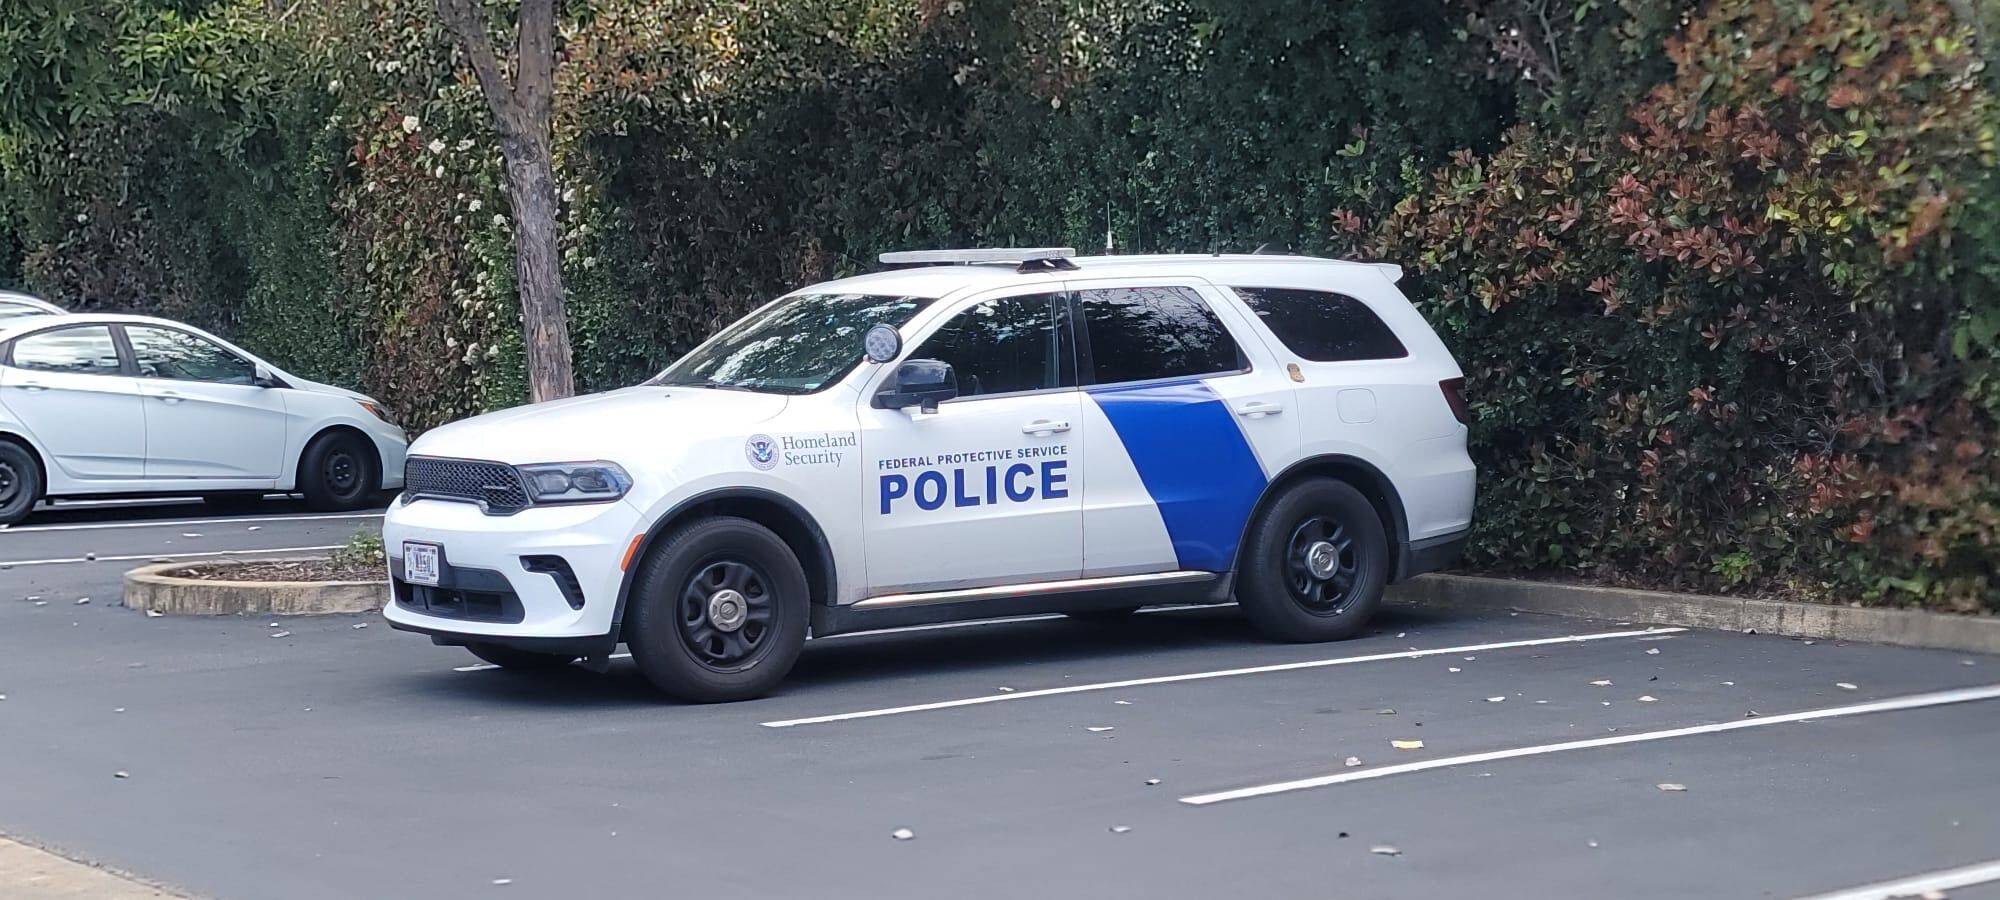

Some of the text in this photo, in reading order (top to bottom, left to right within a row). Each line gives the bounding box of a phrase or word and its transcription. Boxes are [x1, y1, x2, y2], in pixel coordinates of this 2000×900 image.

[782, 432, 857, 450] Homeland
[785, 450, 843, 468] Security
[879, 445, 1068, 470] FEDERAL PROTECTIVE SERVICE
[879, 460, 1069, 515] POLICE
